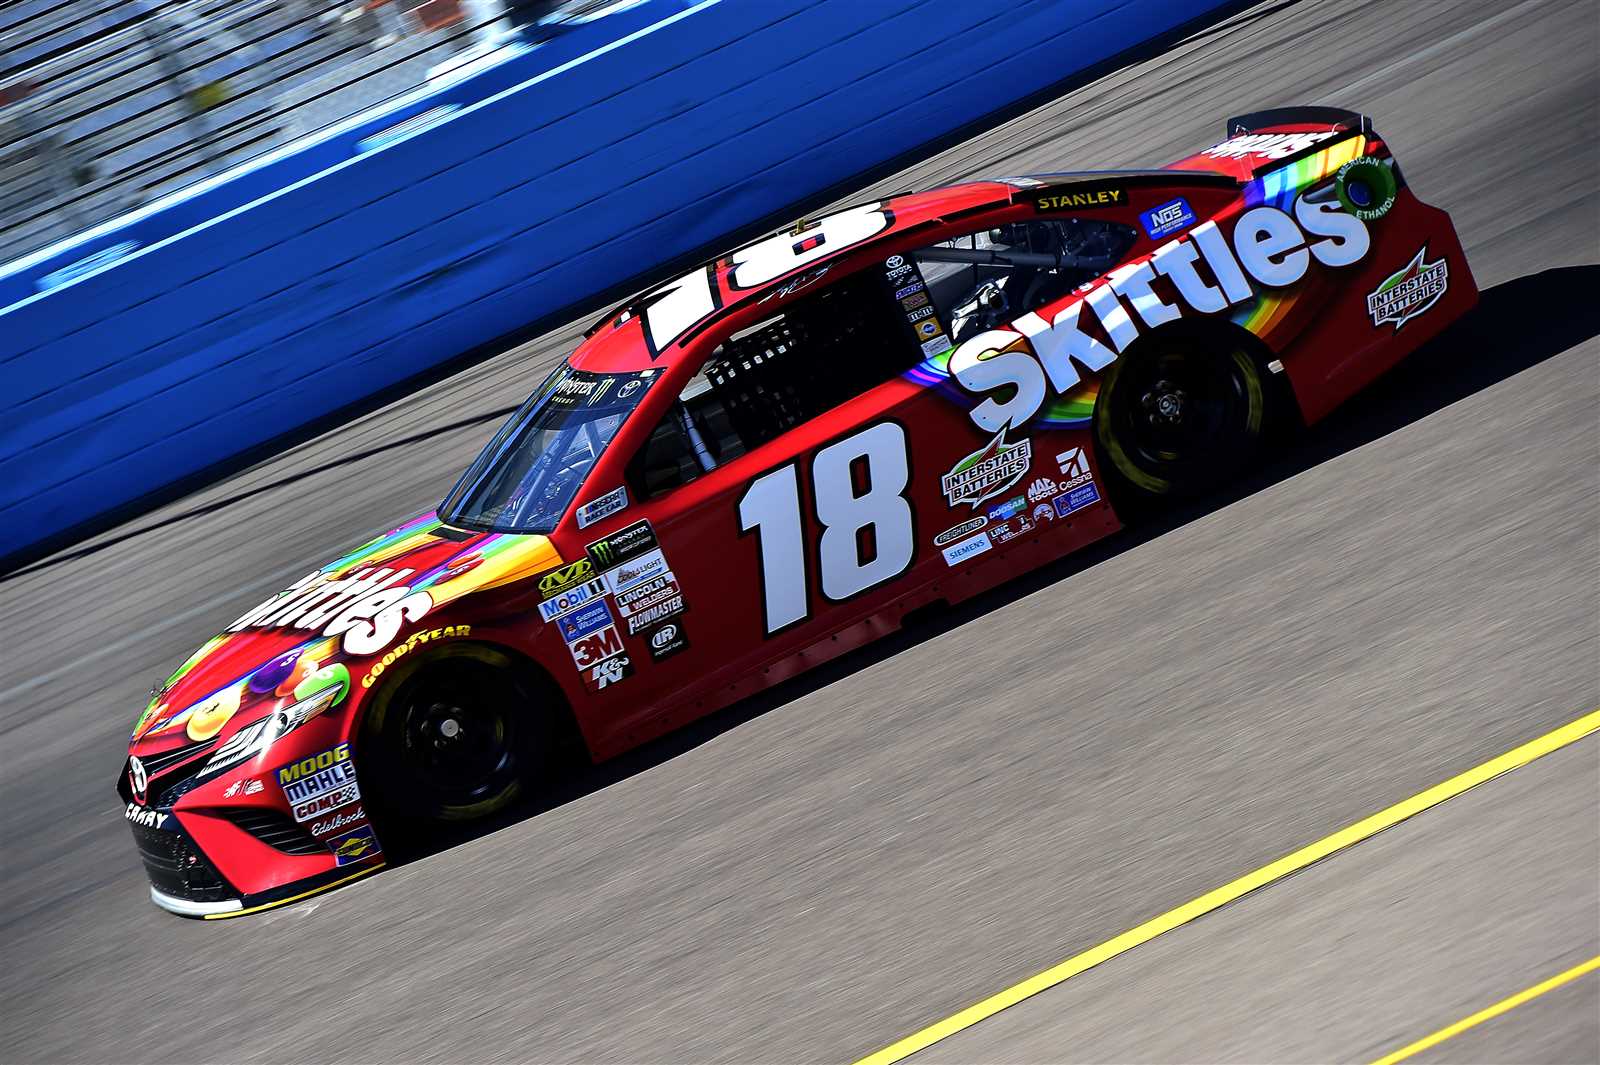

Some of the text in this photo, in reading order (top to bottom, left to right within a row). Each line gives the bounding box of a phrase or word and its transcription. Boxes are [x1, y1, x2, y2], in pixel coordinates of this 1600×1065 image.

[1337, 156, 1379, 182] AMERICAN
[1038, 190, 1121, 210] STANLEY
[1151, 201, 1183, 227] NOS
[1356, 193, 1395, 220] ETHANOL
[645, 201, 888, 352] 18
[886, 264, 912, 277] TOYOTA
[1372, 265, 1443, 308] INTERSTATE
[1379, 279, 1442, 318] BATTERIES
[948, 193, 1371, 433] Skittles
[947, 445, 1026, 488] INTERSTATE
[953, 459, 1025, 499] BATTERIES
[1028, 487, 1058, 502] TOOLS
[1059, 472, 1092, 491] Cessna
[989, 497, 1025, 519] DOOSAN
[739, 421, 914, 634] 18
[938, 518, 983, 543] FREIGHTLINER
[949, 539, 985, 560] SIEMENS
[640, 558, 662, 573] LIGHT
[543, 585, 588, 616] Mobil
[591, 580, 601, 594] 1
[619, 577, 666, 606] LINCOLN
[632, 586, 673, 610] WELDERS
[628, 596, 683, 635] FLOWMASTER
[573, 629, 622, 667] 3M
[654, 627, 676, 648] IR
[362, 624, 471, 688] GOODYEAR
[279, 743, 350, 785] MOOG
[287, 761, 356, 802] MAHLE
[296, 791, 343, 818] COMP
[311, 808, 366, 837] Edelbrock
